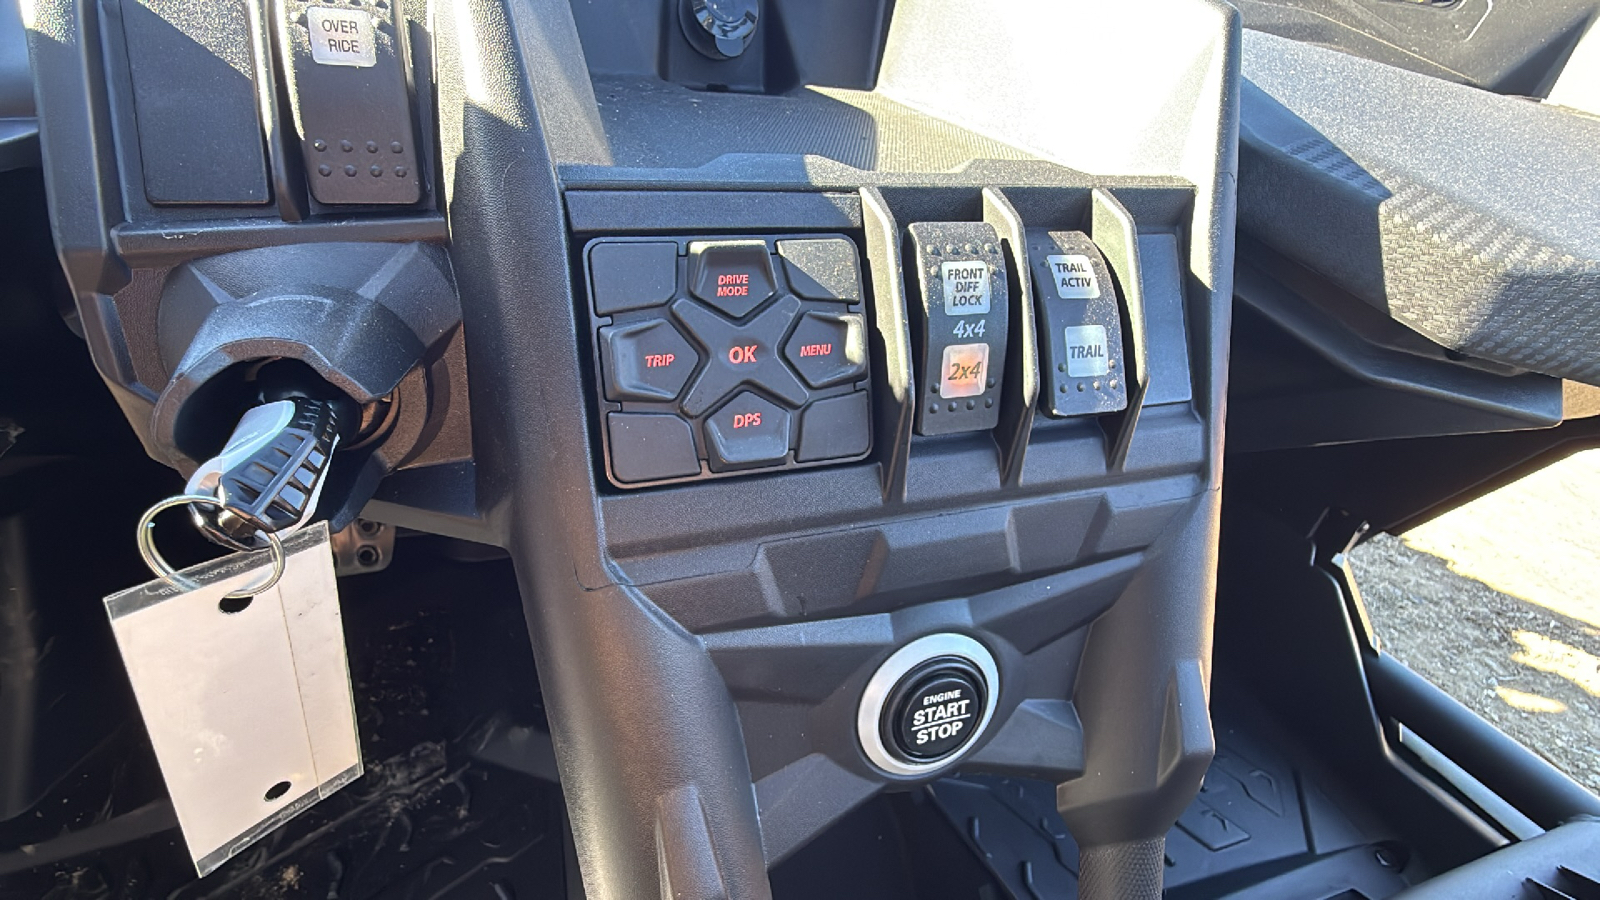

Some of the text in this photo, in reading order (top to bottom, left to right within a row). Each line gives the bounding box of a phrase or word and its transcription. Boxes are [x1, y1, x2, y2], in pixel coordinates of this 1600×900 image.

[321, 19, 359, 34] OVER
[947, 267, 984, 281] FRONT
[1055, 262, 1088, 274] TRAIL
[717, 274, 749, 286] DRIVE
[955, 281, 980, 293] DIFF
[1061, 276, 1091, 288] ACTIV
[716, 286, 748, 297] MODE
[952, 294, 983, 307] LOCK
[952, 319, 986, 339] 4x4
[728, 345, 758, 364] OK
[800, 343, 832, 358] MENU
[1069, 344, 1104, 359] TRAIL
[645, 353, 675, 368] TRIP
[947, 361, 982, 381] 2x4
[733, 412, 762, 429] DPS
[922, 689, 962, 706] ENGINE
[913, 699, 971, 726] START
[916, 721, 963, 745] STOP
